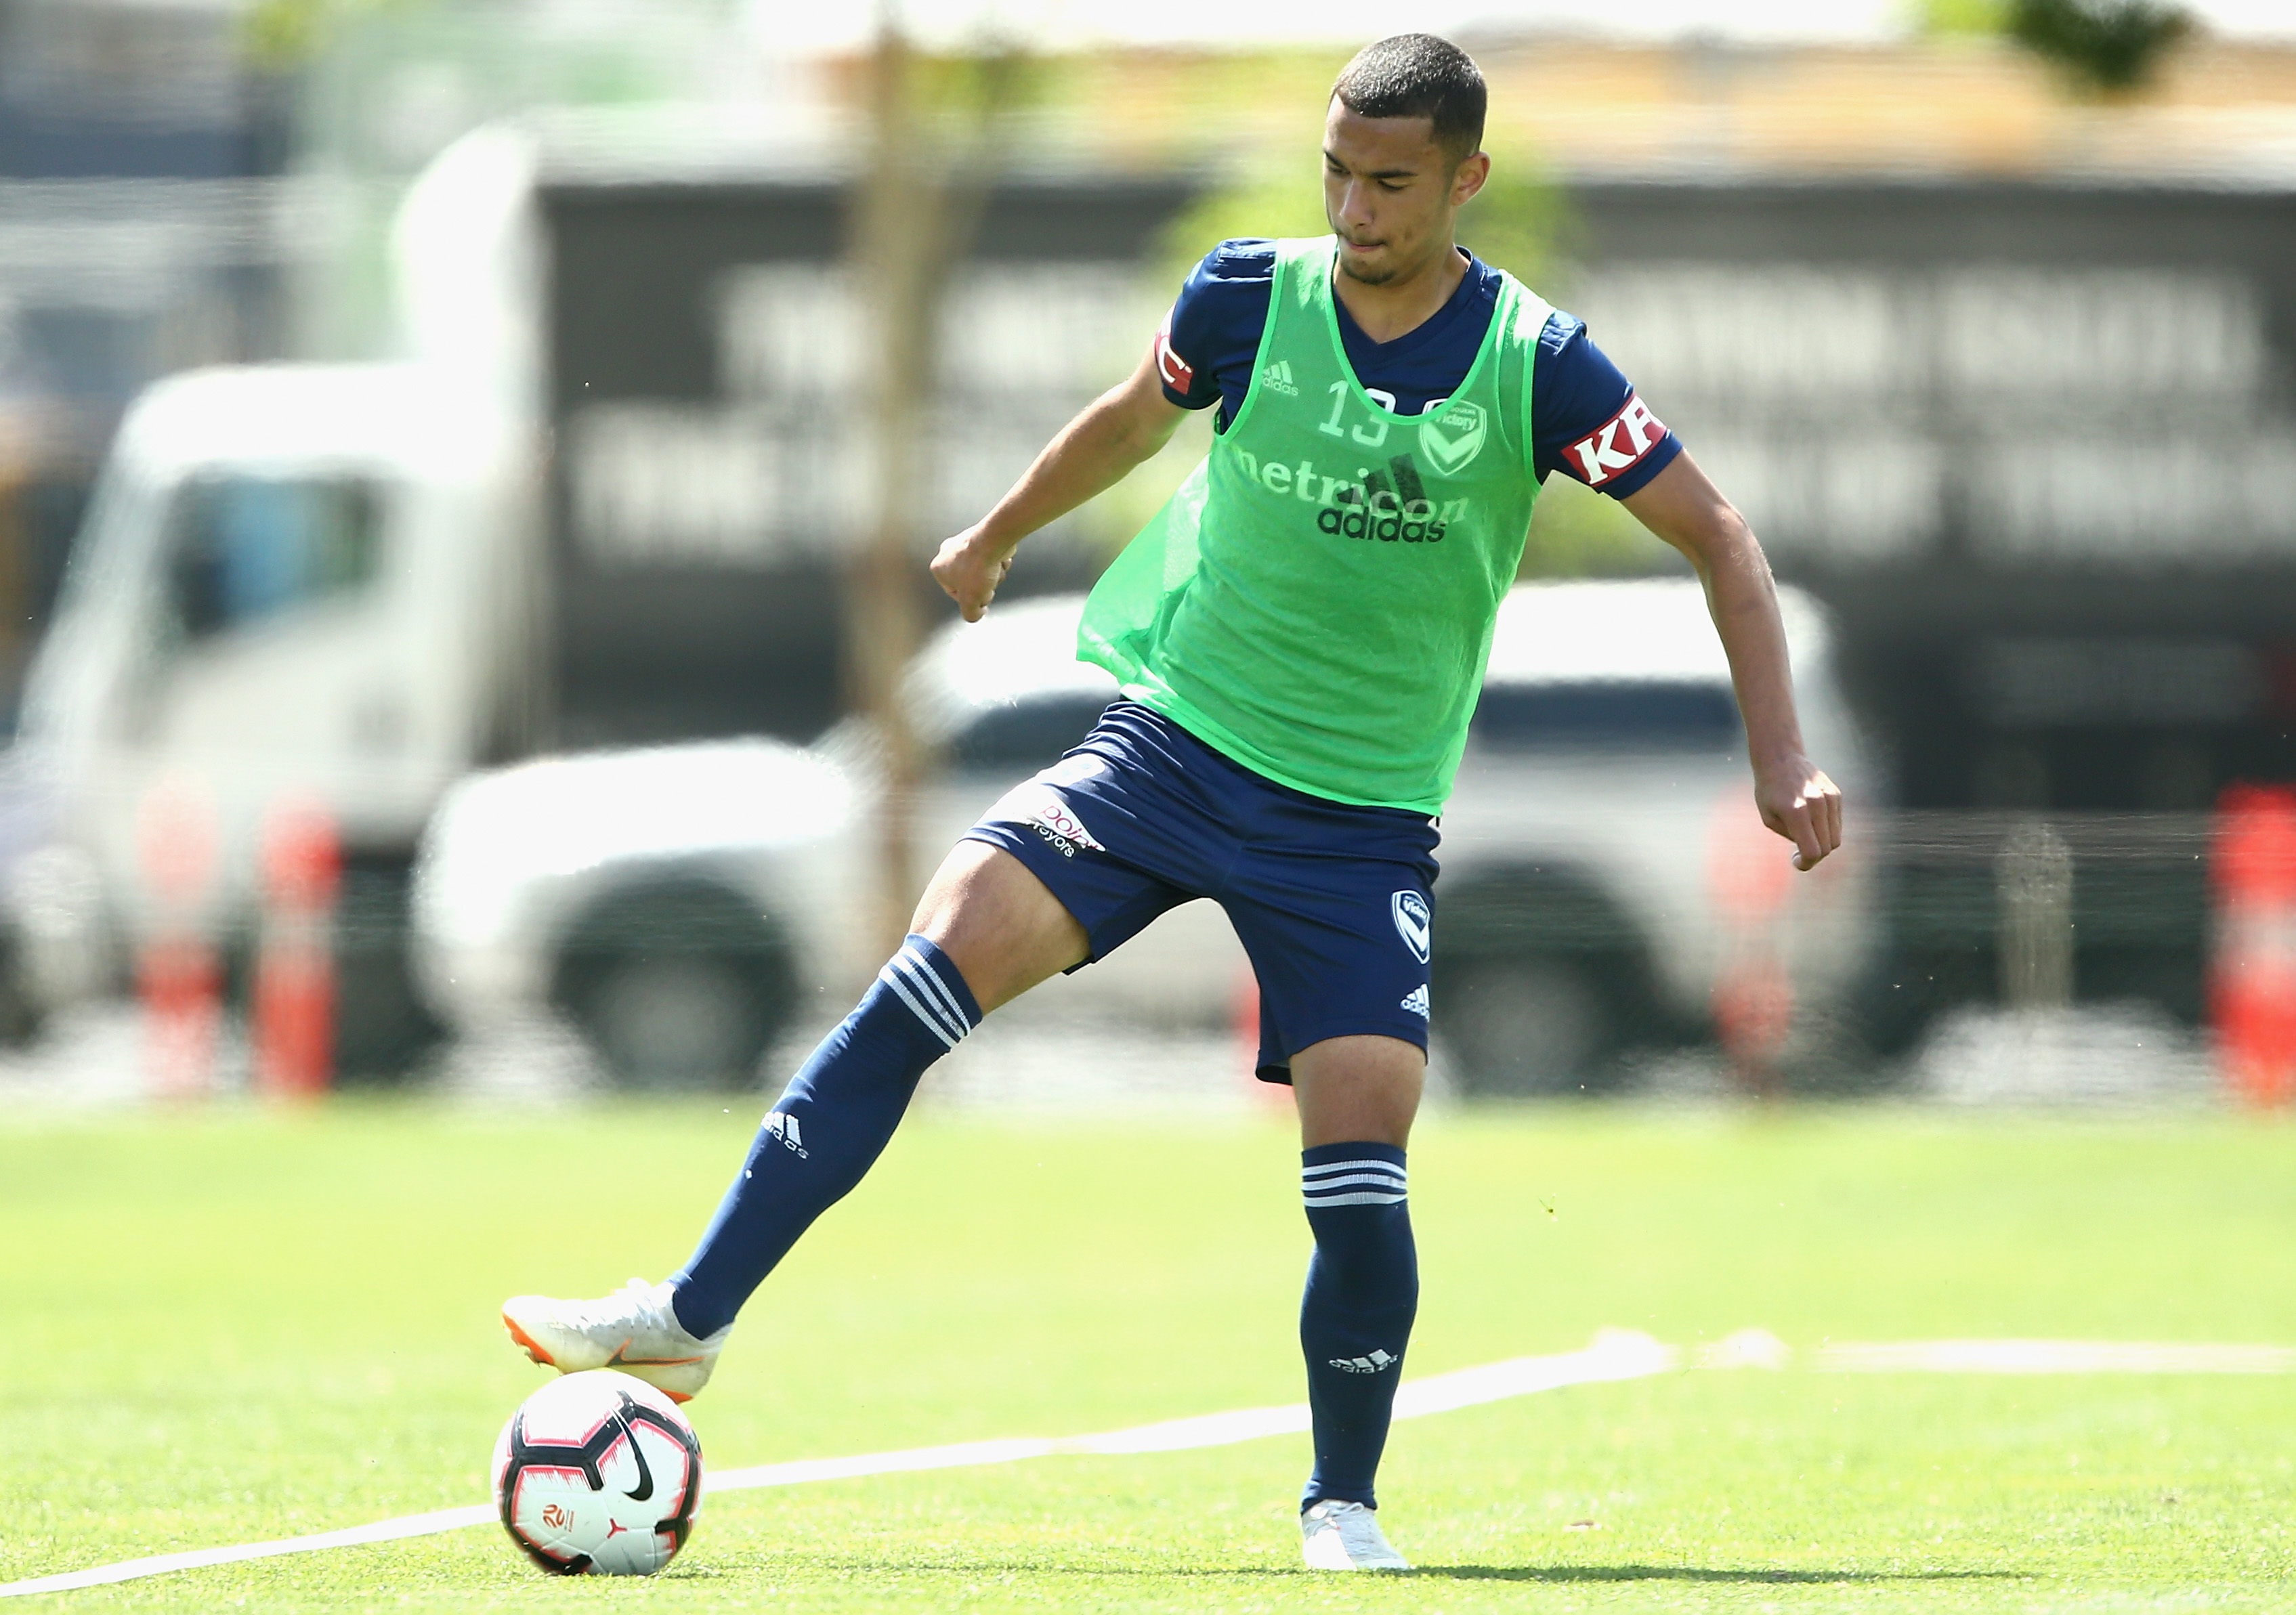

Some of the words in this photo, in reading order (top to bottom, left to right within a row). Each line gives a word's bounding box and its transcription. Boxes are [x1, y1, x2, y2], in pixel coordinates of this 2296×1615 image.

[1262, 376, 1299, 396] didas
[1434, 412, 1477, 431] ictory
[1574, 395, 1664, 484] KF
[1317, 507, 1447, 542] adidas
[1040, 805, 1099, 848] poin
